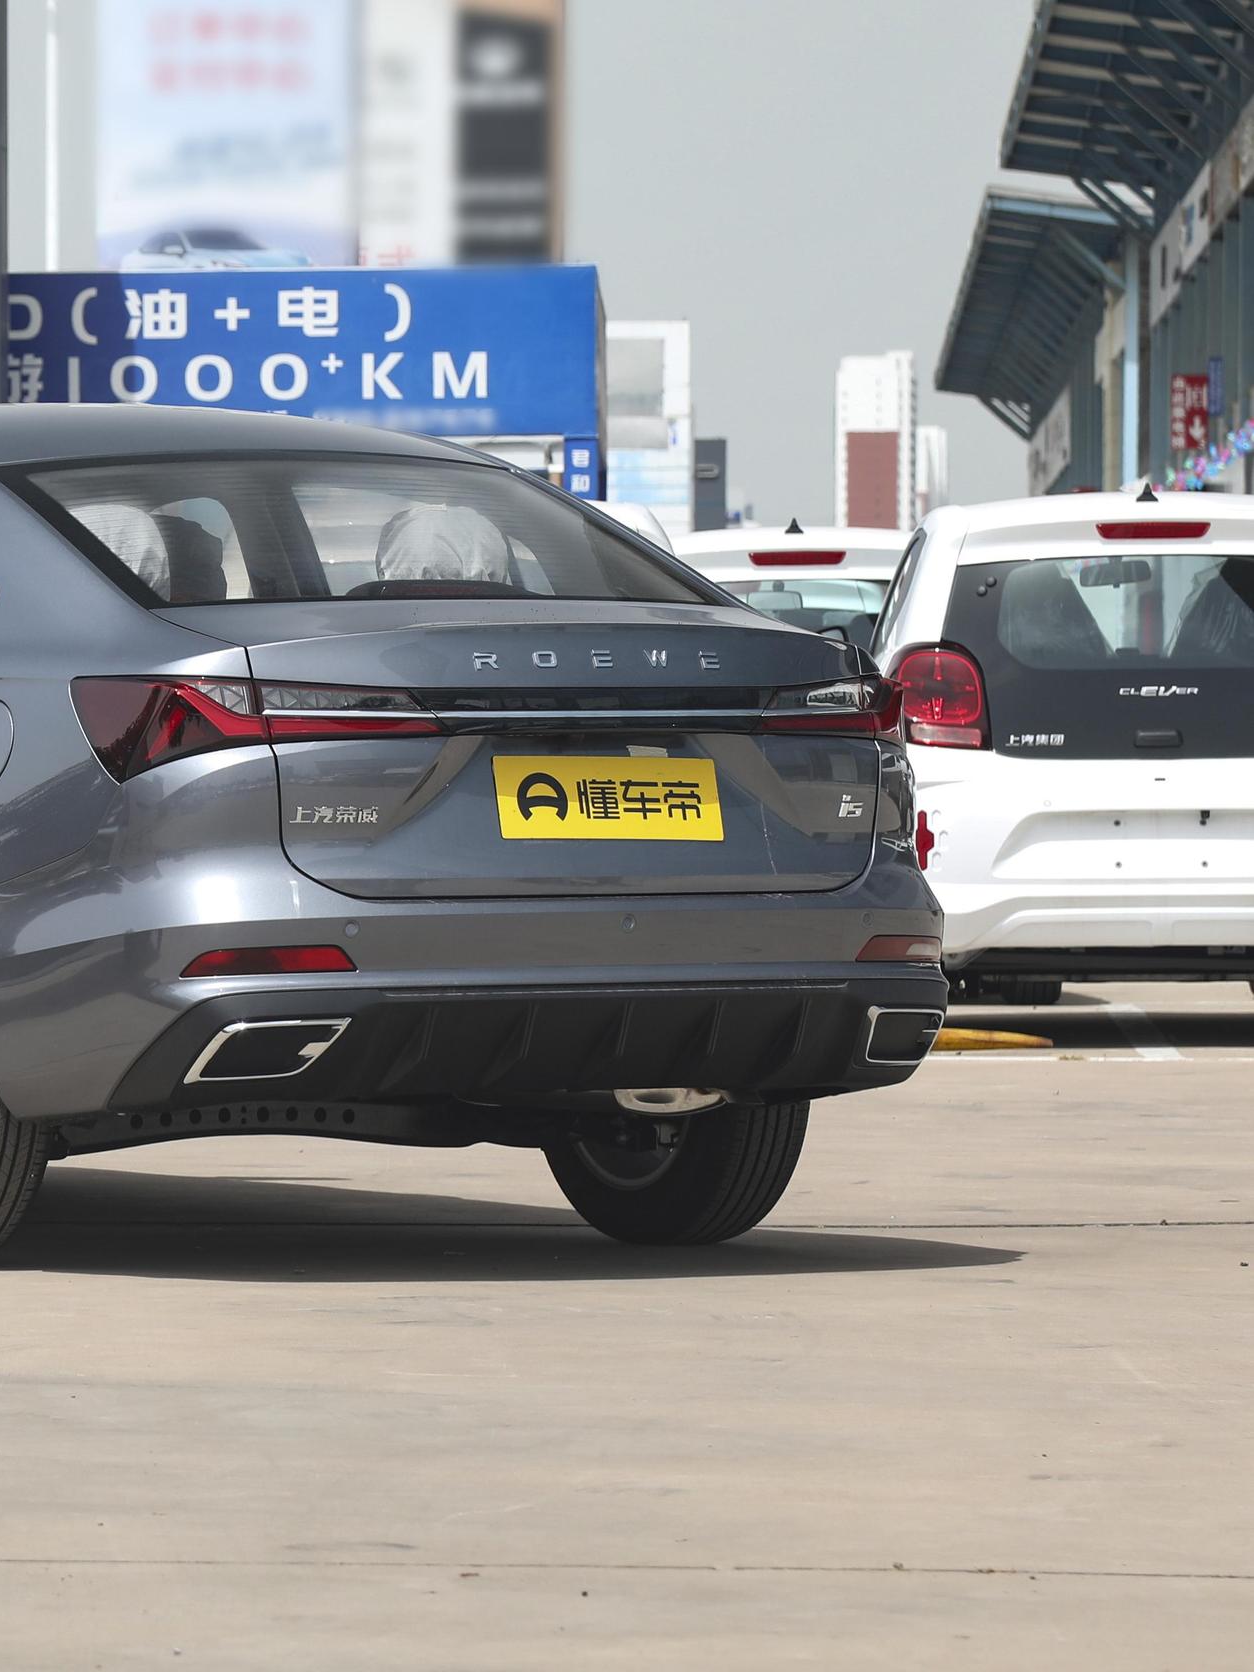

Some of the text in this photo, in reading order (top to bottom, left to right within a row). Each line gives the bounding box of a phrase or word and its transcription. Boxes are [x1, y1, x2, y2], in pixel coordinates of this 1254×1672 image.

[472, 649, 721, 672] ROEWE
[1118, 685, 1199, 697] CLEVER
[1005, 733, 1065, 747] 上汽集团
[575, 778, 702, 821] 懂车帝
[838, 794, 864, 818] i5
[289, 806, 379, 824] 上汽荣威
